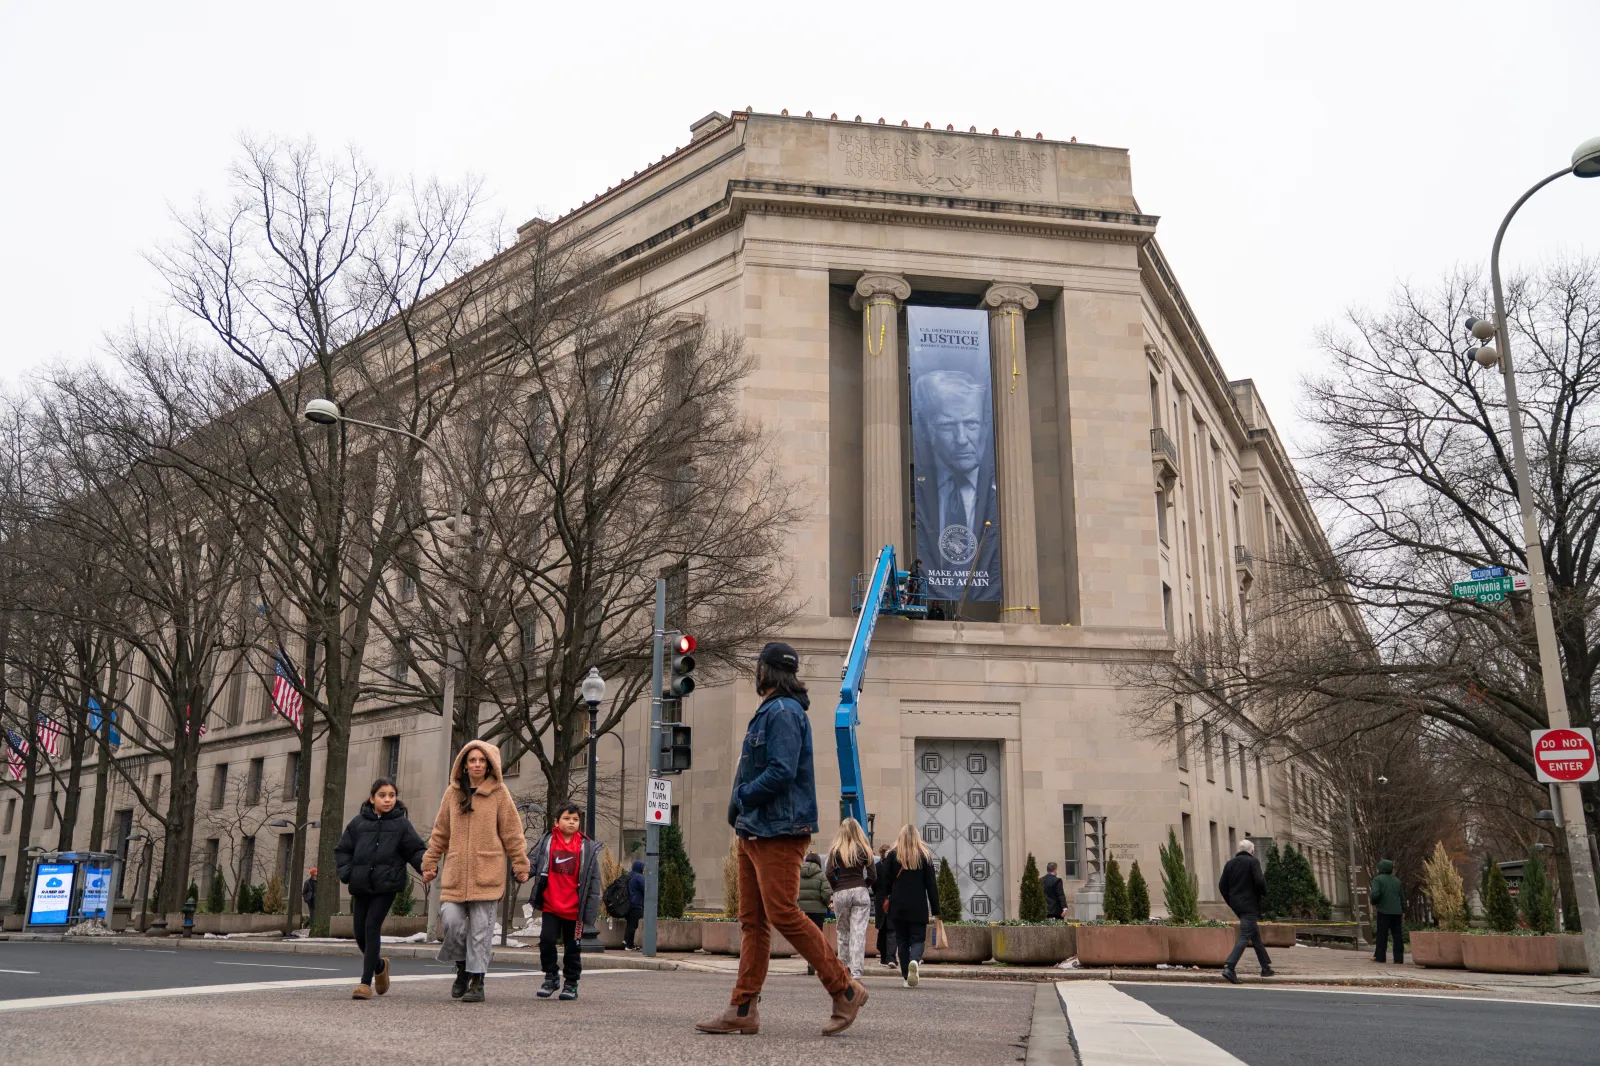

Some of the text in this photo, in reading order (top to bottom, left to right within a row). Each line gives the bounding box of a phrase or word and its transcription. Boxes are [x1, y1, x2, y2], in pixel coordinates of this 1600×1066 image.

[840, 135, 909, 149] JUSTICE IN
[838, 142, 909, 157] CONDUCT OF
[978, 147, 1047, 160] THE LIFE AND
[846, 151, 909, 166] POSSIBLE
[979, 156, 997, 166] THE
[1003, 158, 1032, 168] STATE
[857, 161, 898, 173] RESIDES
[901, 165, 911, 174] IN
[974, 164, 1041, 178] ONLY AS FIRST
[844, 168, 914, 183] AND SOULS OF
[980, 172, 1042, 186] THE HEARTS
[978, 181, 1043, 194] THE CITIZENS
[920, 333, 979, 347] JUSTICE
[928, 576, 955, 586] SAFE
[1454, 579, 1500, 596] Pennsylvania
[1480, 592, 1501, 602] 900
[1541, 739, 1583, 748] DO NOT
[1549, 761, 1583, 771] ENTER
[654, 781, 665, 791] NO
[652, 791, 667, 800] TURN
[648, 800, 669, 810] ON RED
